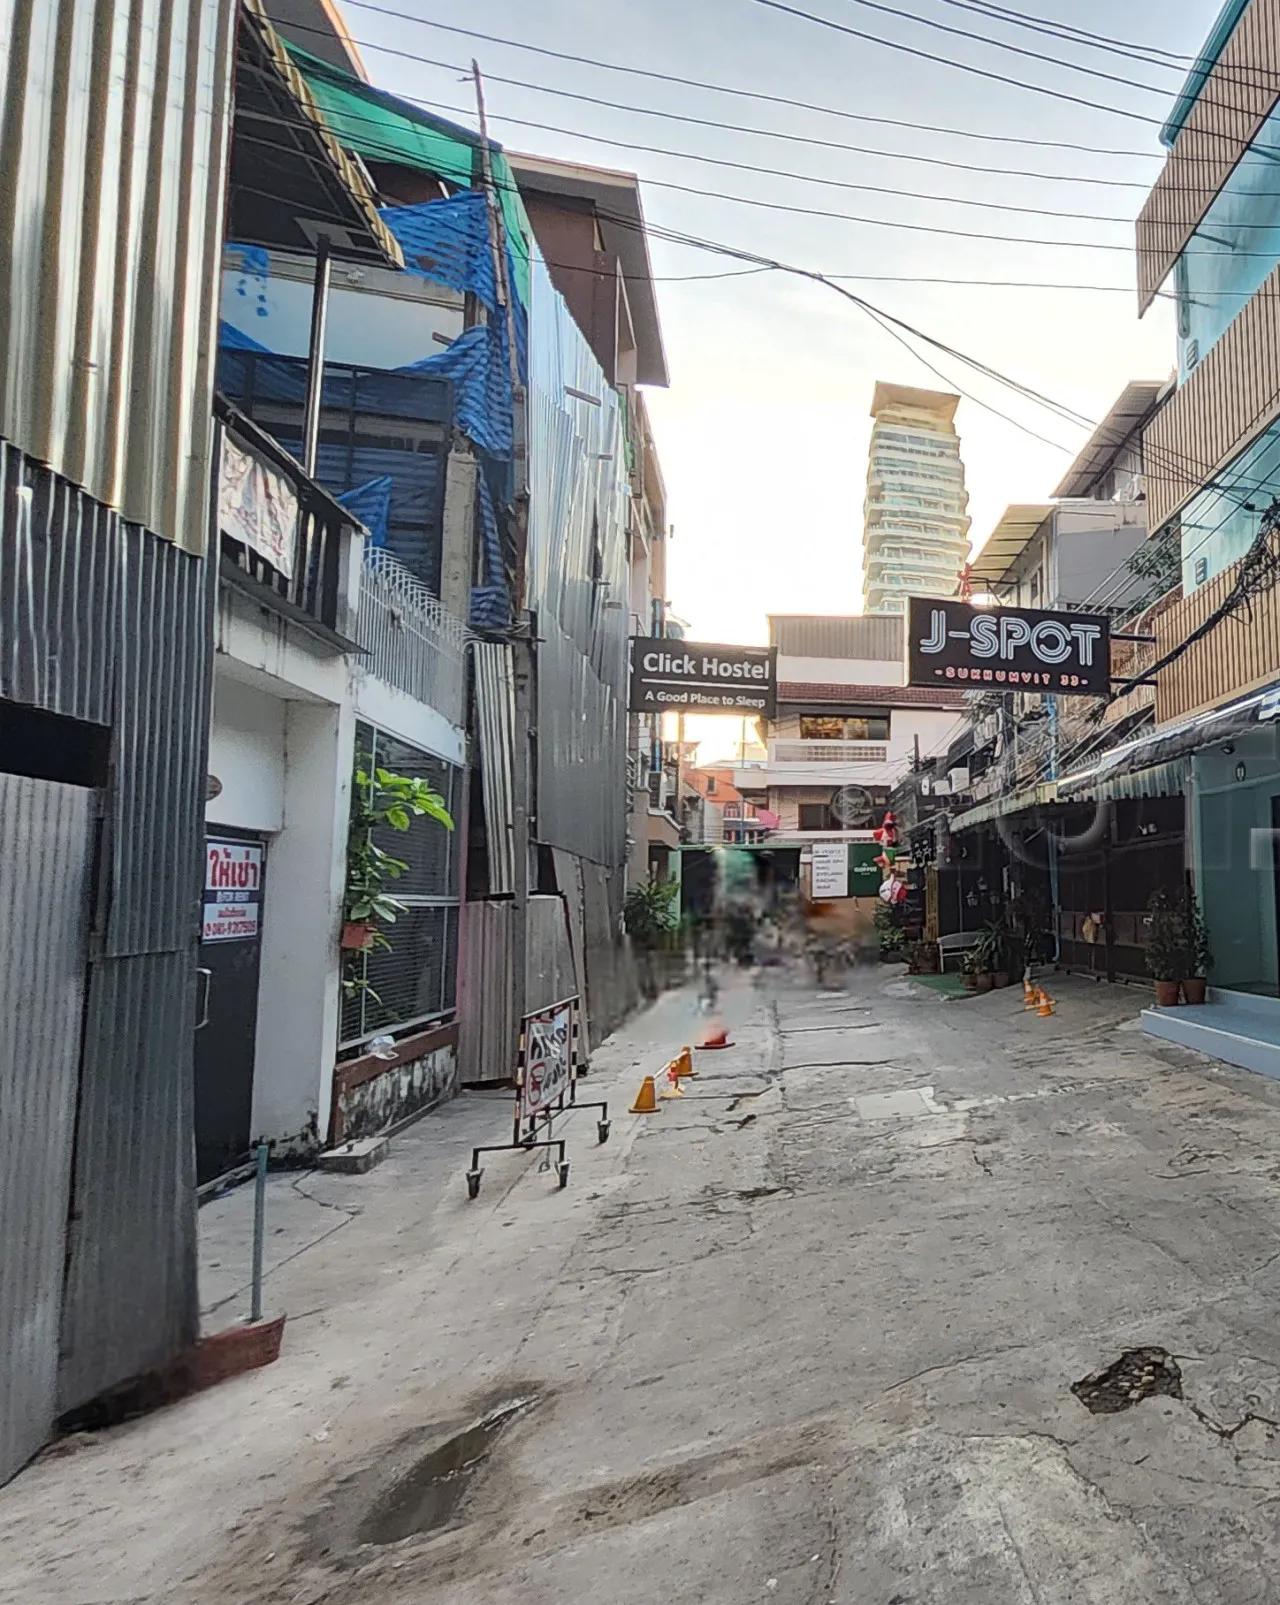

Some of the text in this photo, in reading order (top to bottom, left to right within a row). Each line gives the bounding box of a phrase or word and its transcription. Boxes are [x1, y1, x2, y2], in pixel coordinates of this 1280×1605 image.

[920, 609, 1101, 666] J-SPOT
[643, 653, 769, 679] Click Hostel
[645, 690, 766, 708] A Good Place to Sleep
[209, 847, 257, 887] ให้เช่า
